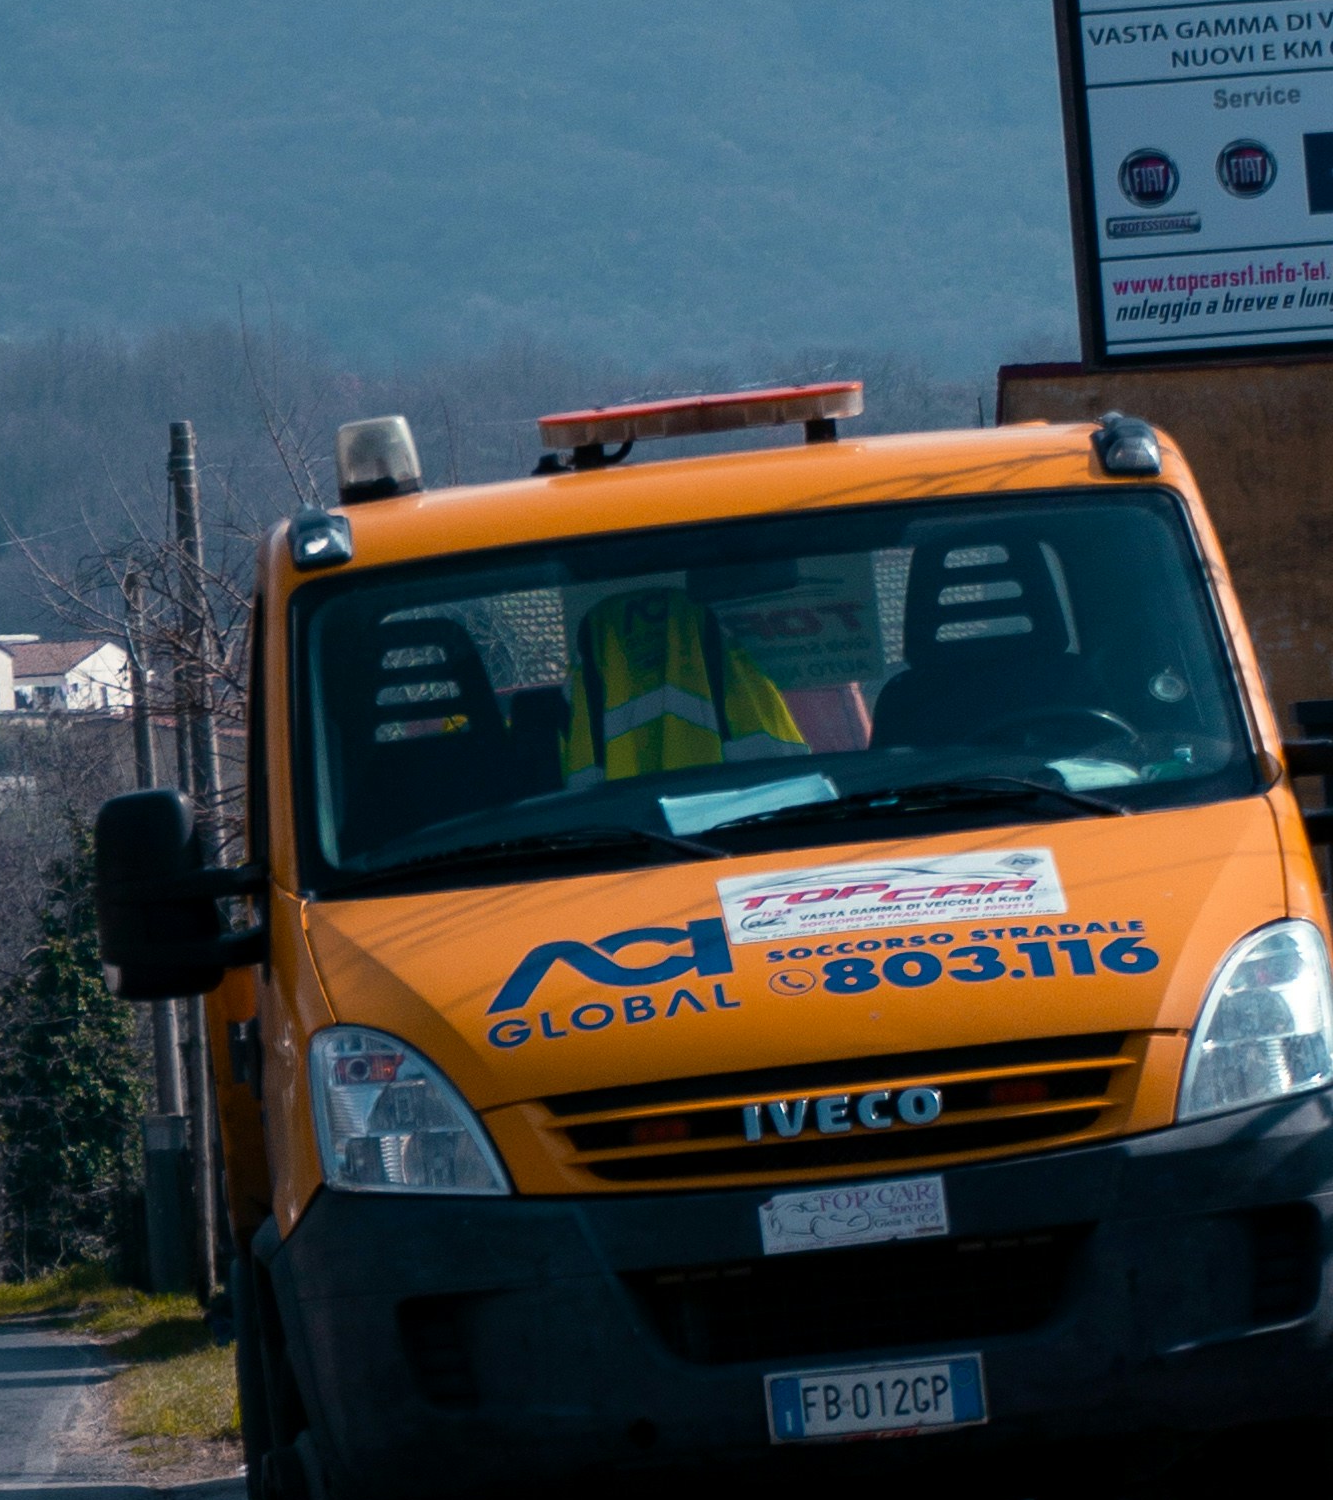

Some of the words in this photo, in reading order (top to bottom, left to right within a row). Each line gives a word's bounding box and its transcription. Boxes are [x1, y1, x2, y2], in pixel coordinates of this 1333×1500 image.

[1087, 23, 1167, 46] VASTA
[1176, 15, 1278, 40] GAMMA
[1286, 13, 1311, 30] DI
[1171, 45, 1254, 68] NUOVI
[1263, 43, 1276, 60] E
[1283, 41, 1322, 59] KM
[1213, 86, 1301, 109] Service
[1133, 165, 1165, 193] FIAT
[1230, 156, 1263, 184] FIAT
[1116, 298, 1201, 325] noleggio
[1206, 299, 1217, 315] a
[1221, 292, 1278, 313] breve
[1283, 294, 1295, 309] e
[738, 883, 891, 911] TOP
[879, 879, 1037, 903] CAR
[799, 909, 844, 921] VASTA
[850, 905, 901, 916] GAMMA
[906, 903, 920, 912] DI
[925, 898, 981, 908] VEICOLI
[999, 895, 1019, 904] Km
[765, 932, 954, 963] SOCCORSO
[969, 920, 1145, 942] STRADALE
[486, 917, 733, 1016] ACI
[822, 937, 1160, 995] 803.116
[488, 984, 740, 1048] GLOBAL
[743, 1087, 942, 1142] IVECO
[802, 1385, 842, 1422] FB
[851, 1375, 949, 1419] 012GP
